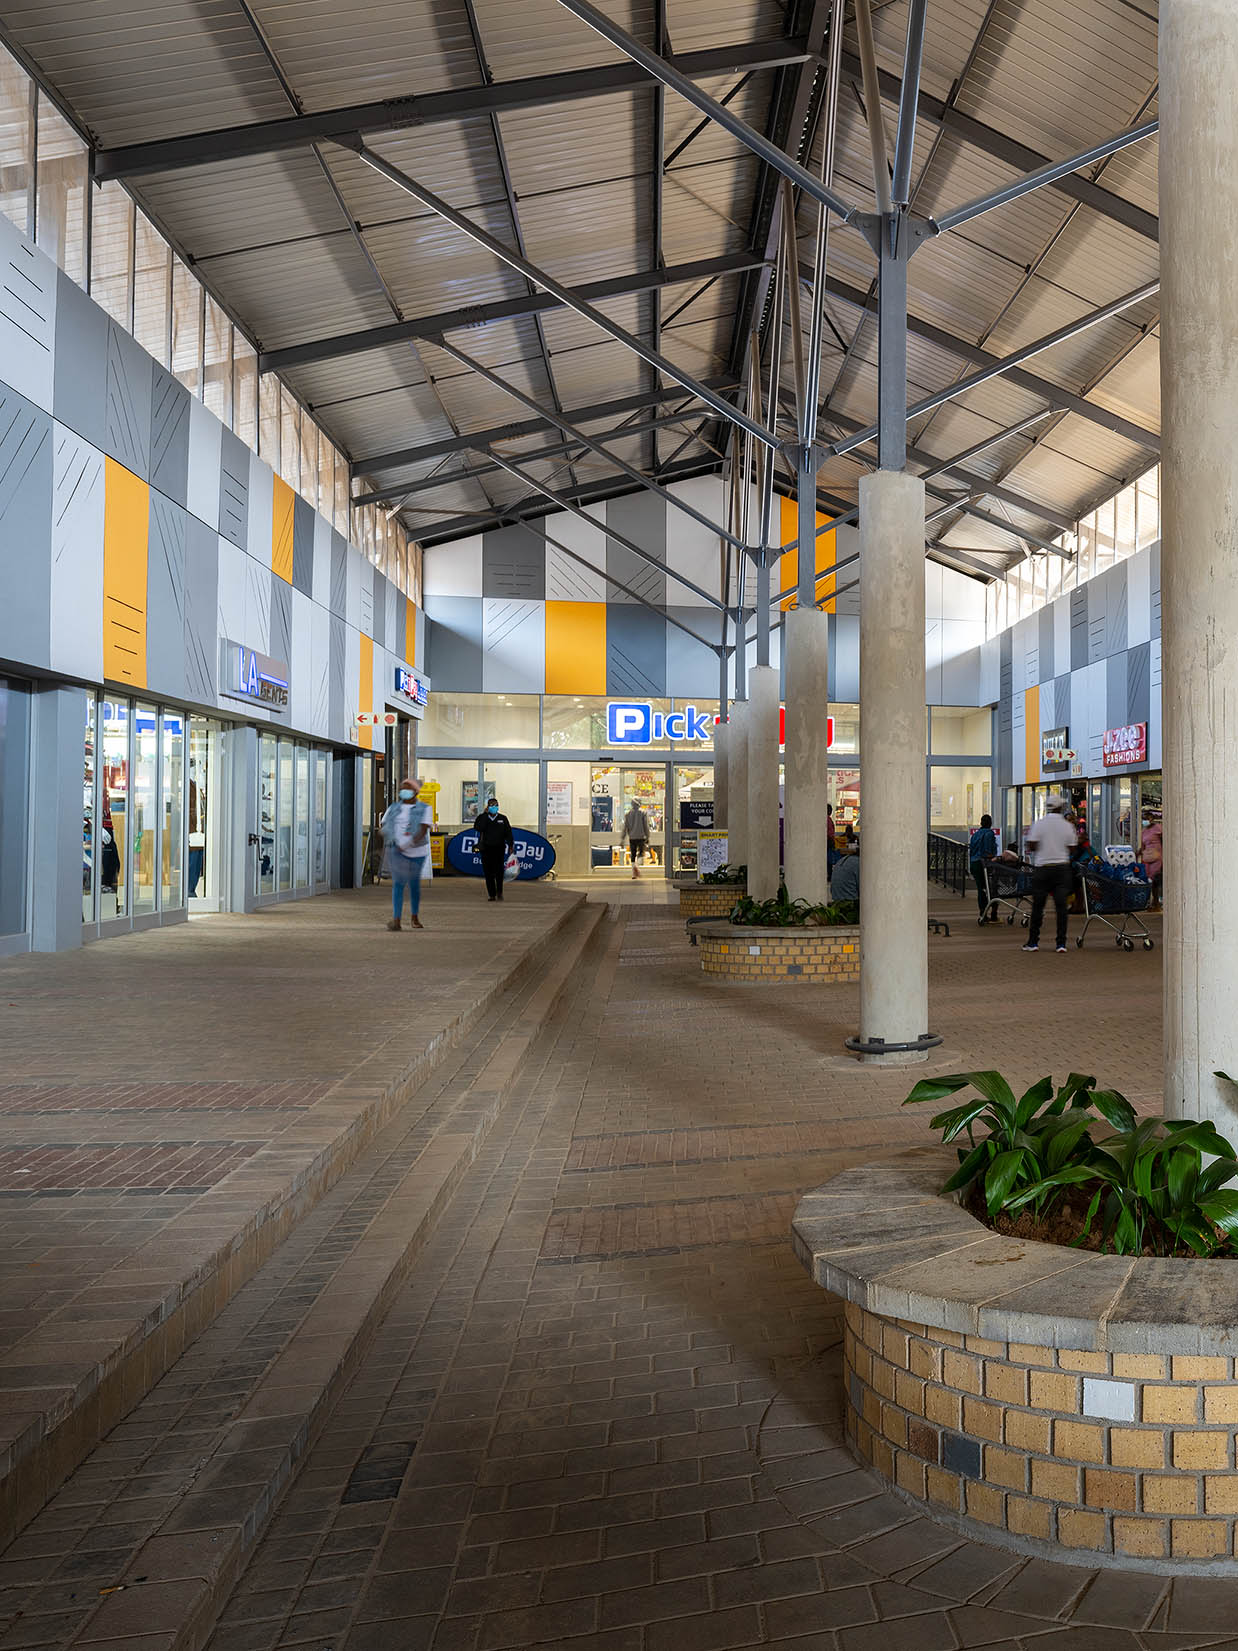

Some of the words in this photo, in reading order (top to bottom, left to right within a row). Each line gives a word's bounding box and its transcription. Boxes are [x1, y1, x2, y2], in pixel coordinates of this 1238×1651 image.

[239, 646, 259, 696] LA
[260, 681, 288, 705] GENTS
[607, 702, 711, 745] Pick
[1106, 750, 1140, 764] FASHIONS
